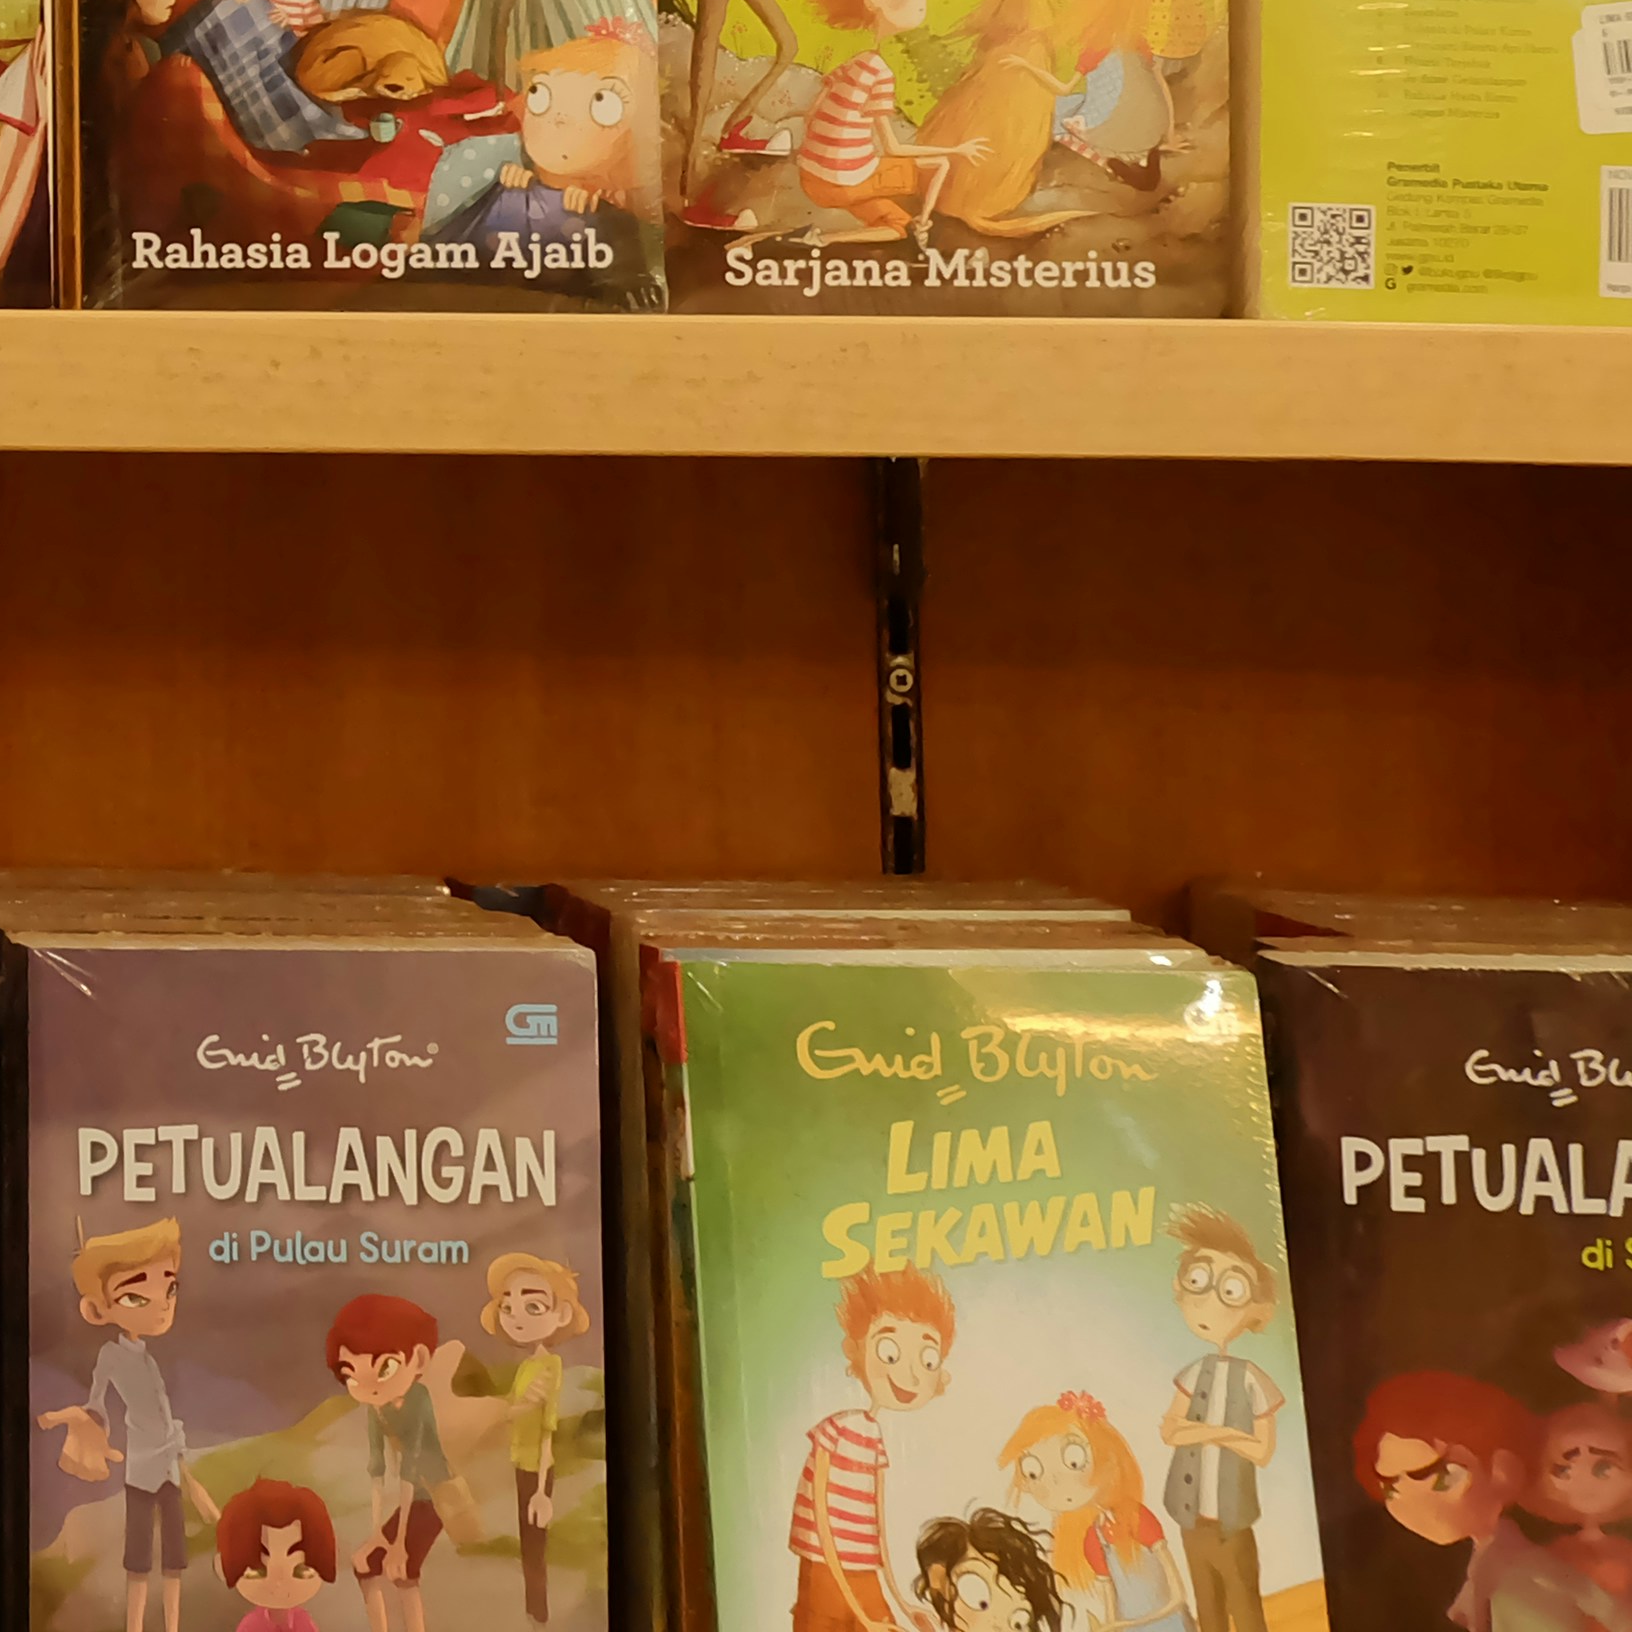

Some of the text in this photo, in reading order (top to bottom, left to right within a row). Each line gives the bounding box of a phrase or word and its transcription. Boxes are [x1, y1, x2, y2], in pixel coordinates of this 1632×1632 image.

[132, 228, 615, 279] Rahasia Logam Ajaib
[725, 248, 1157, 298] Sarjana Misterius
[196, 1033, 287, 1072] Enid
[796, 1020, 1158, 1097] Enid Blyton
[1465, 1049, 1562, 1087] Enid
[77, 1124, 556, 1207] PETUALANGAN
[886, 1120, 1062, 1195] LIMA
[208, 1230, 470, 1265] di Pulau Suram
[821, 1186, 1156, 1279] SEKAWAN
[1581, 1238, 1613, 1270] di
